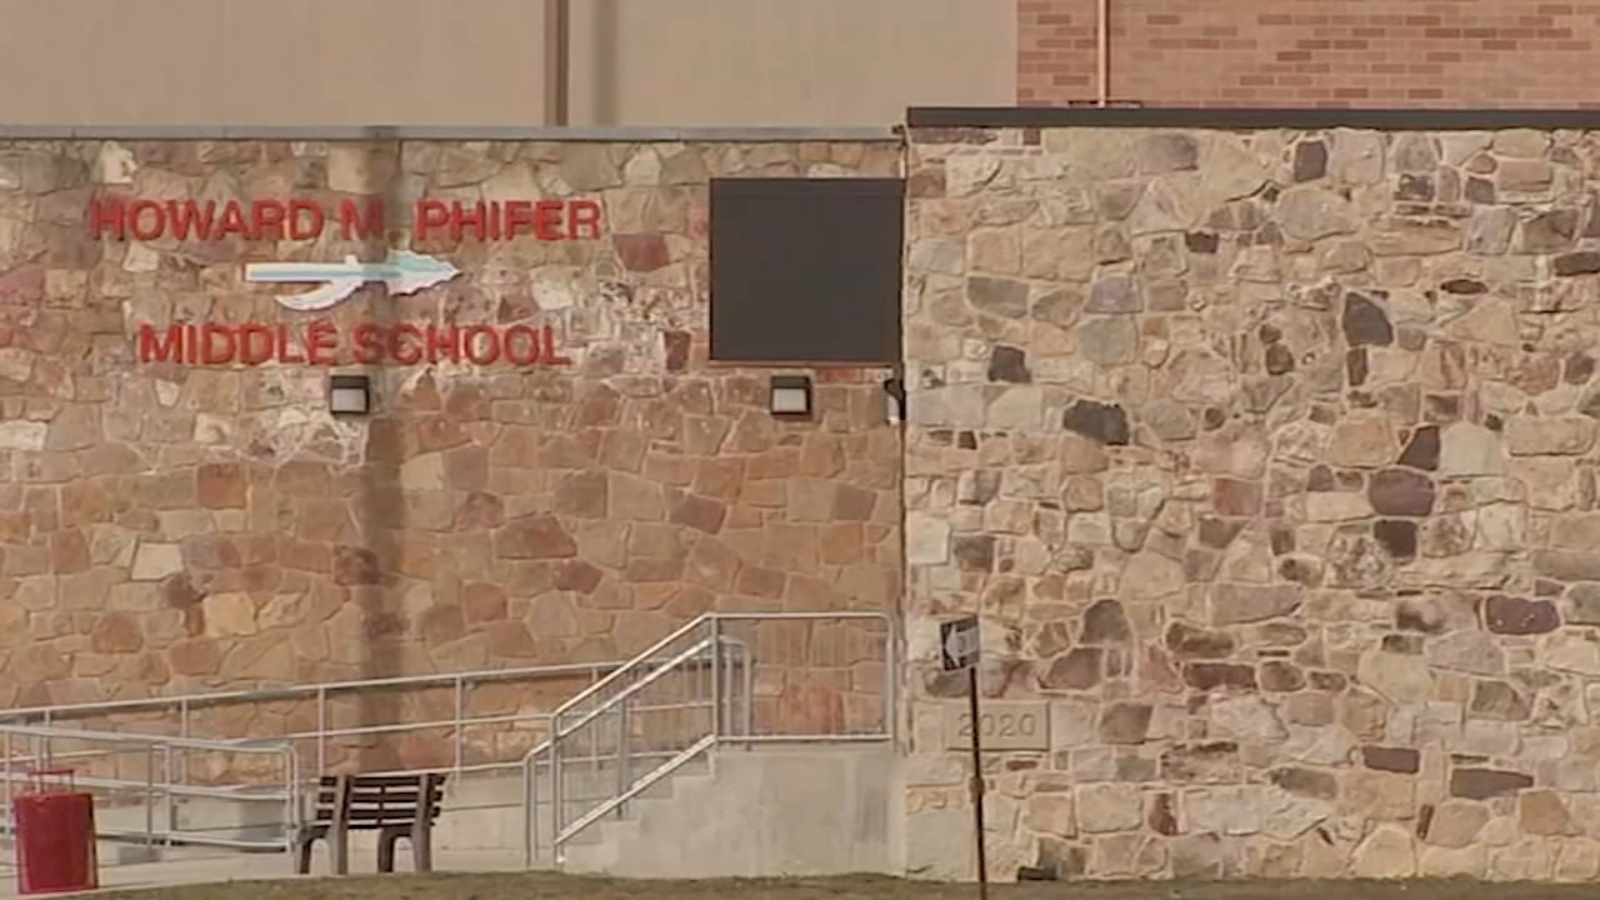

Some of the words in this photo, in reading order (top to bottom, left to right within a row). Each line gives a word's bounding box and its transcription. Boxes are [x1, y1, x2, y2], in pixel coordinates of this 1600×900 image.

[88, 198, 324, 242] HOWARD
[414, 199, 602, 241] PHIFER
[139, 323, 337, 366] MIDDLE
[352, 322, 572, 366] SCHOOL
[958, 712, 1036, 737] 2020
